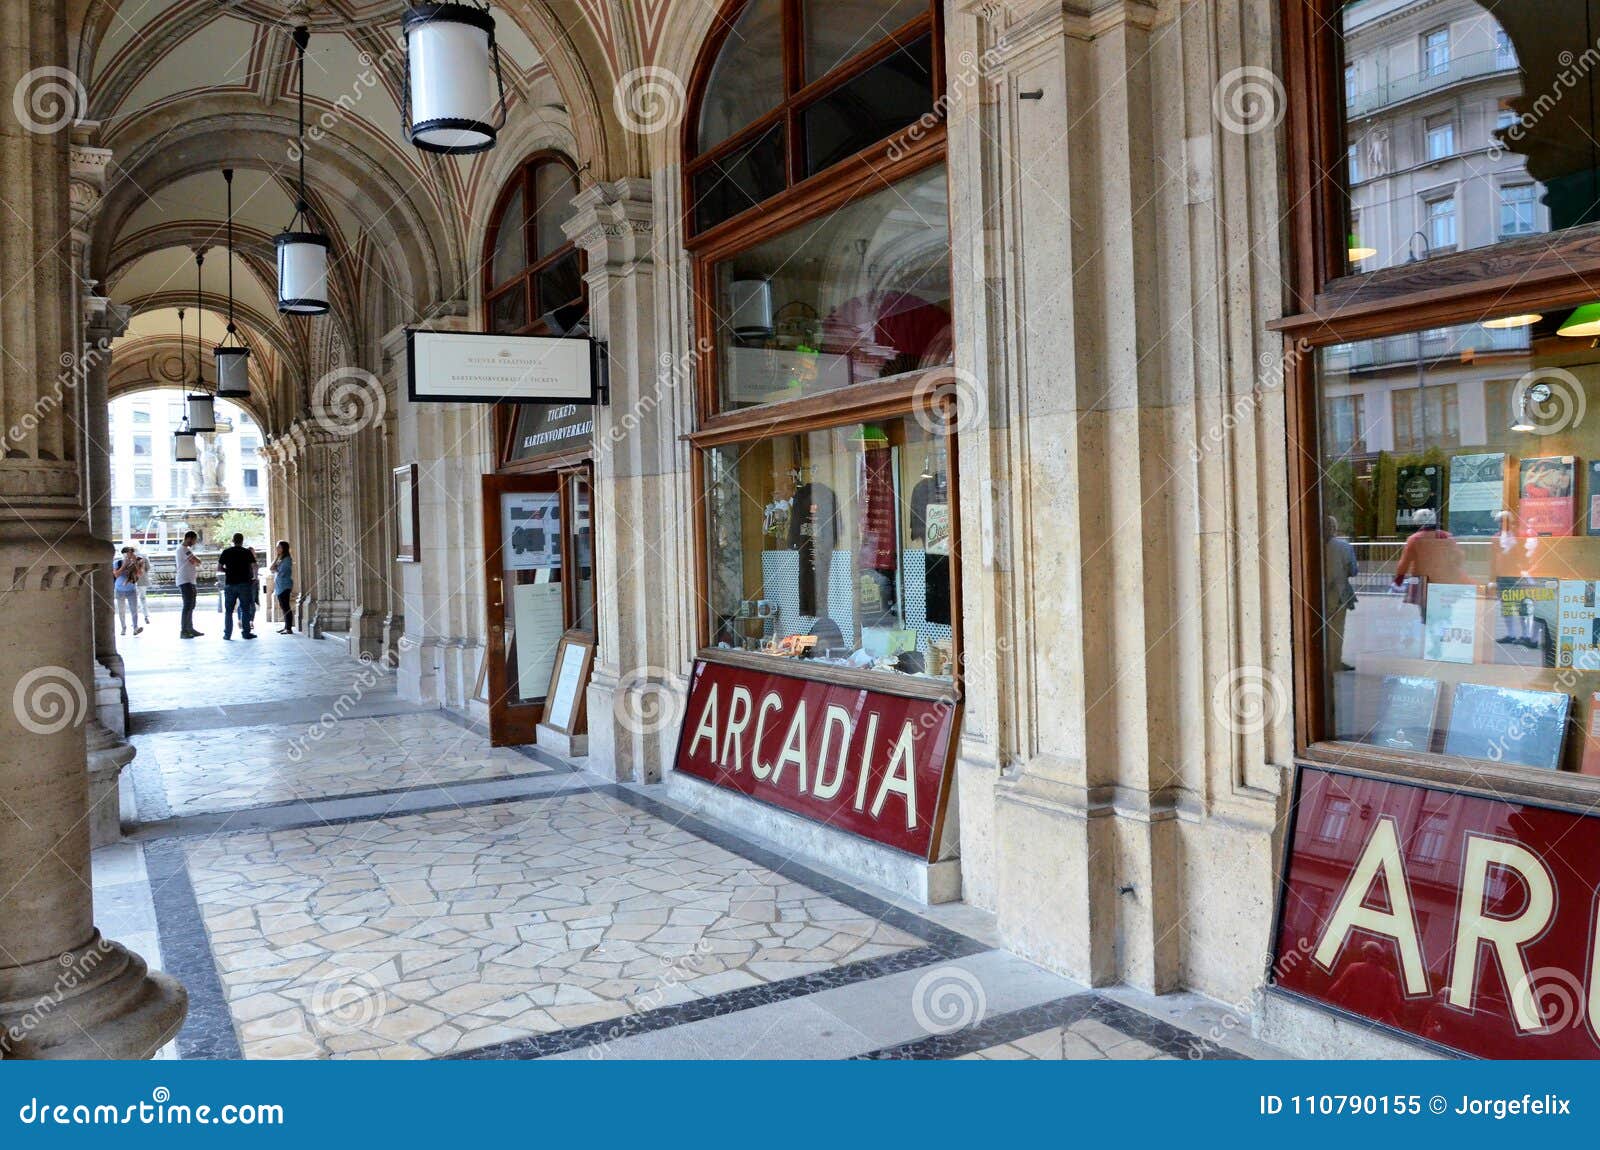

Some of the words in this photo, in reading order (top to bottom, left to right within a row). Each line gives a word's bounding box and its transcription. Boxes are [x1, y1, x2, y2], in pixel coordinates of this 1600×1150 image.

[548, 404, 576, 422] TICKETS
[1563, 595, 1588, 603] DAS
[1563, 611, 1596, 619] BUCH
[1563, 627, 1585, 636] DER
[687, 680, 920, 832] ARCADIA
[1309, 813, 1600, 1048] AR
